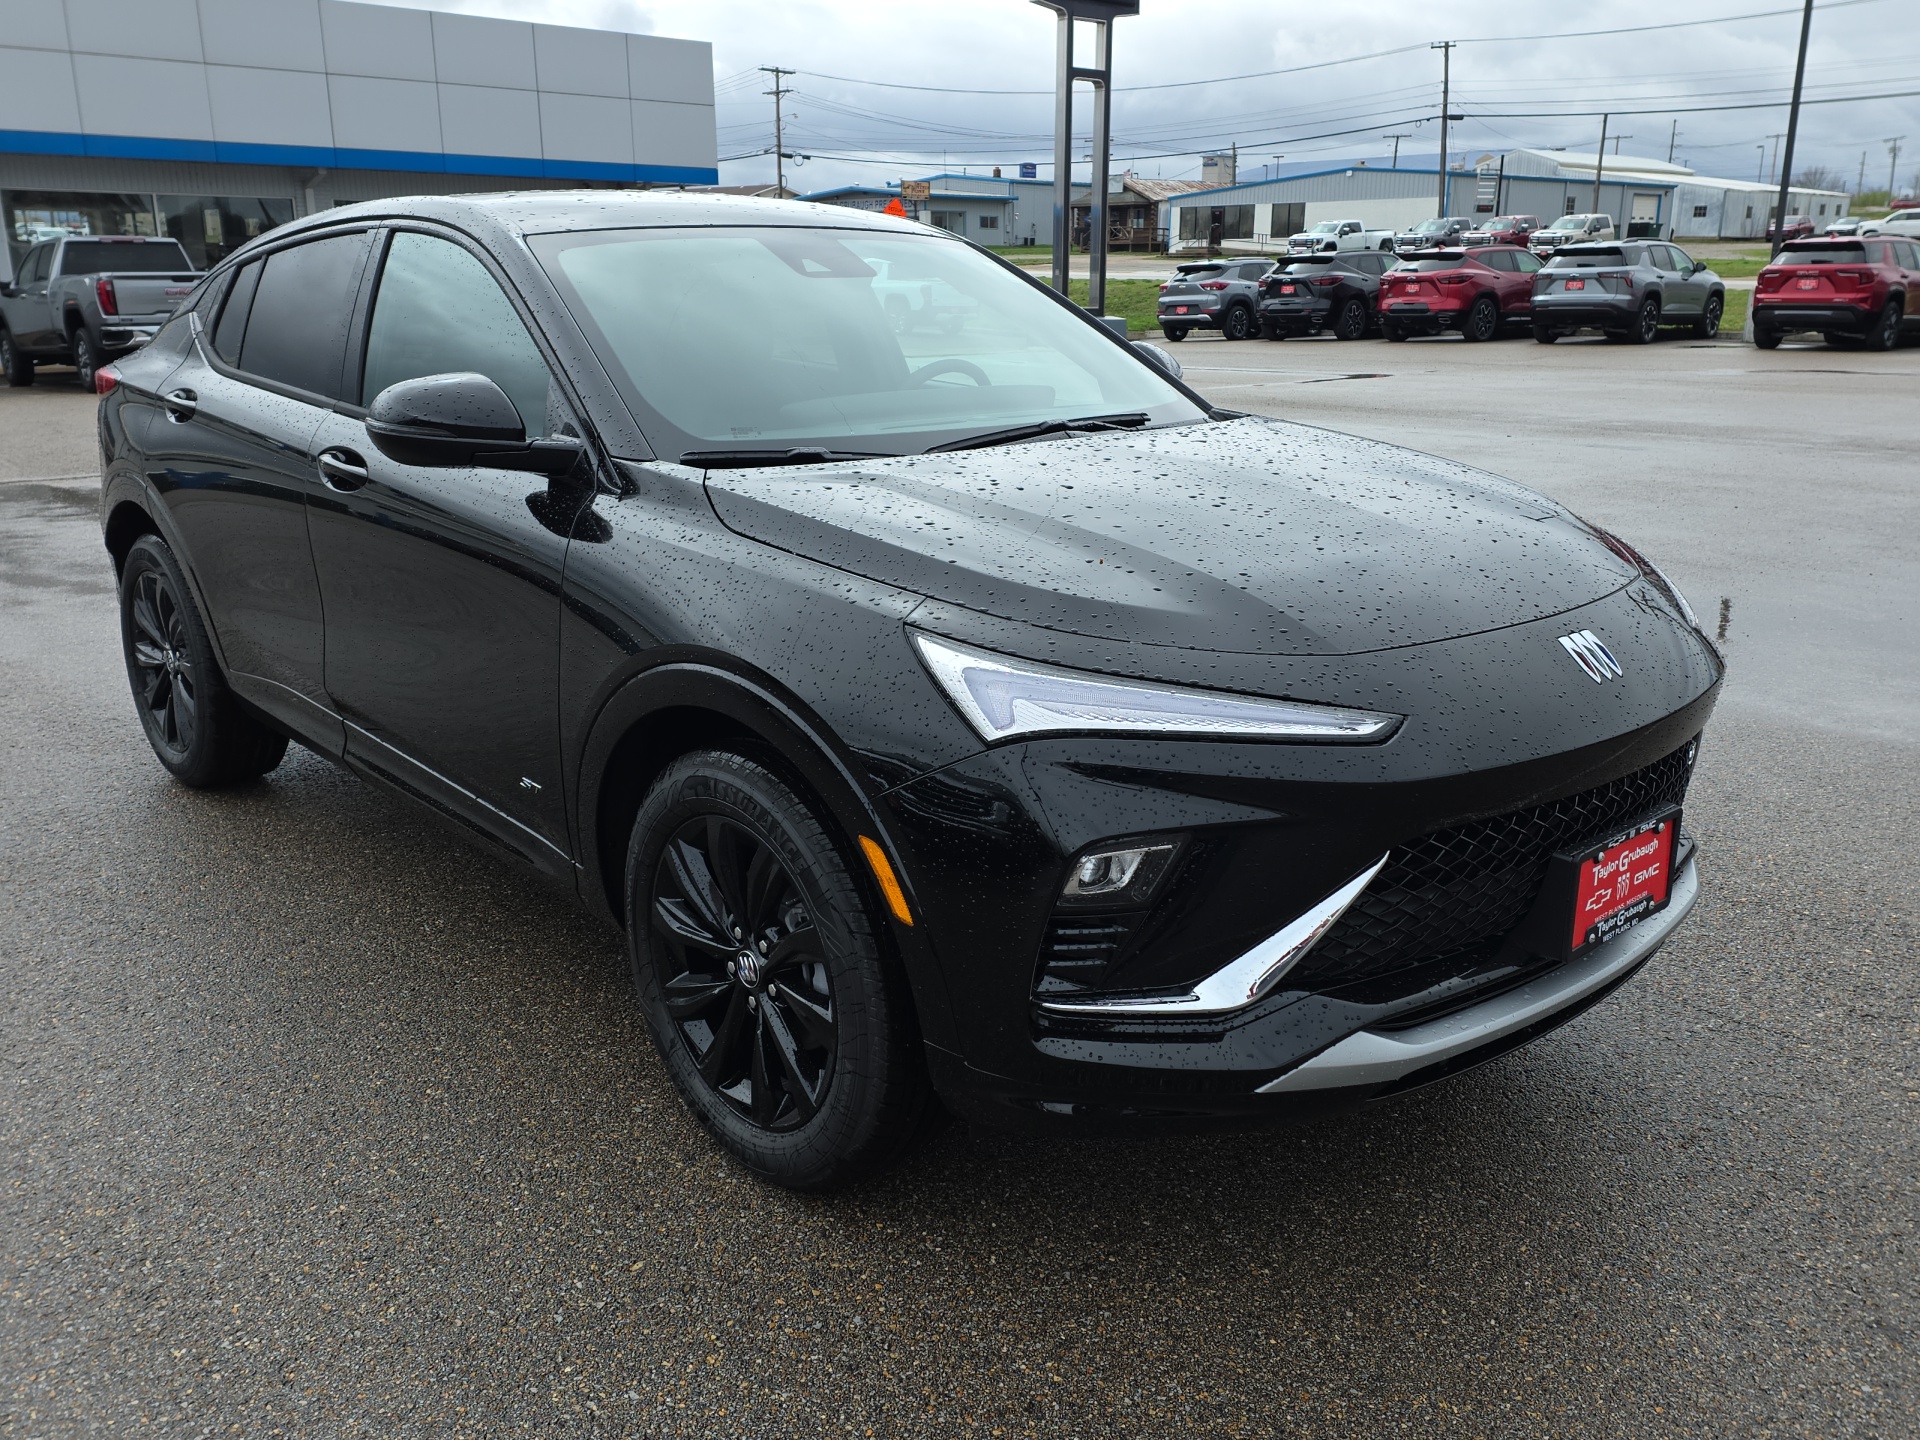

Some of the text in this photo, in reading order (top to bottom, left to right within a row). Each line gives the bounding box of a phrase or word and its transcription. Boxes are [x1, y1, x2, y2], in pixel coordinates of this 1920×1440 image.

[704, 777, 807, 874] ASSURANCE
[1640, 820, 1657, 834] GMC
[1592, 838, 1659, 886] Taylor Grubaugh
[1633, 863, 1660, 885] GMC
[1594, 912, 1609, 924] WEST
[1626, 890, 1648, 906] MISSOURI
[1596, 900, 1647, 937] Taylor Grubaugh
[1602, 931, 1615, 943] WEST
[1632, 917, 1639, 927] MO
